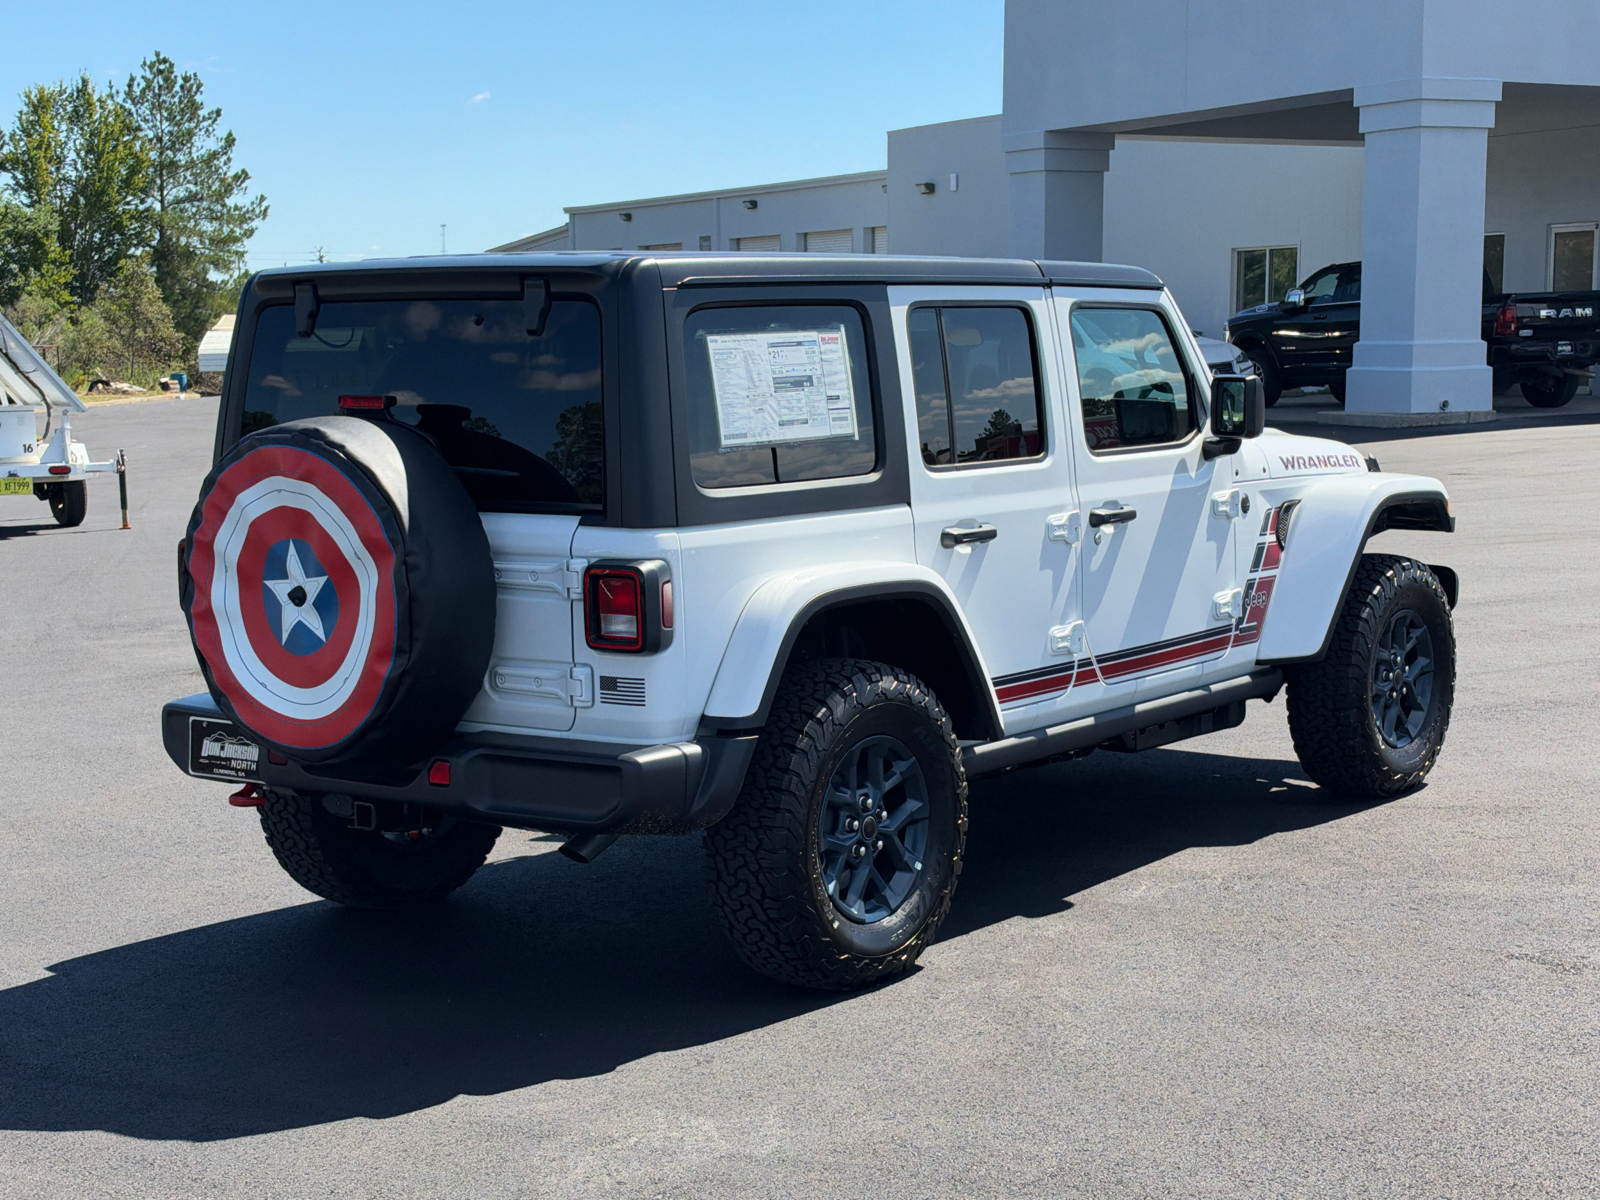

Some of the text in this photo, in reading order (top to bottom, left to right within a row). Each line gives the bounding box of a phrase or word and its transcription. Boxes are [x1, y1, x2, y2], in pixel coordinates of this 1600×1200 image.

[1540, 308, 1592, 318] RAM
[23, 444, 33, 453] 16
[1277, 454, 1361, 470] WRANGLER
[4, 481, 30, 491] XFT999
[1244, 589, 1267, 608] Jeep
[220, 742, 259, 761] JACKSON
[230, 759, 257, 771] NORTH
